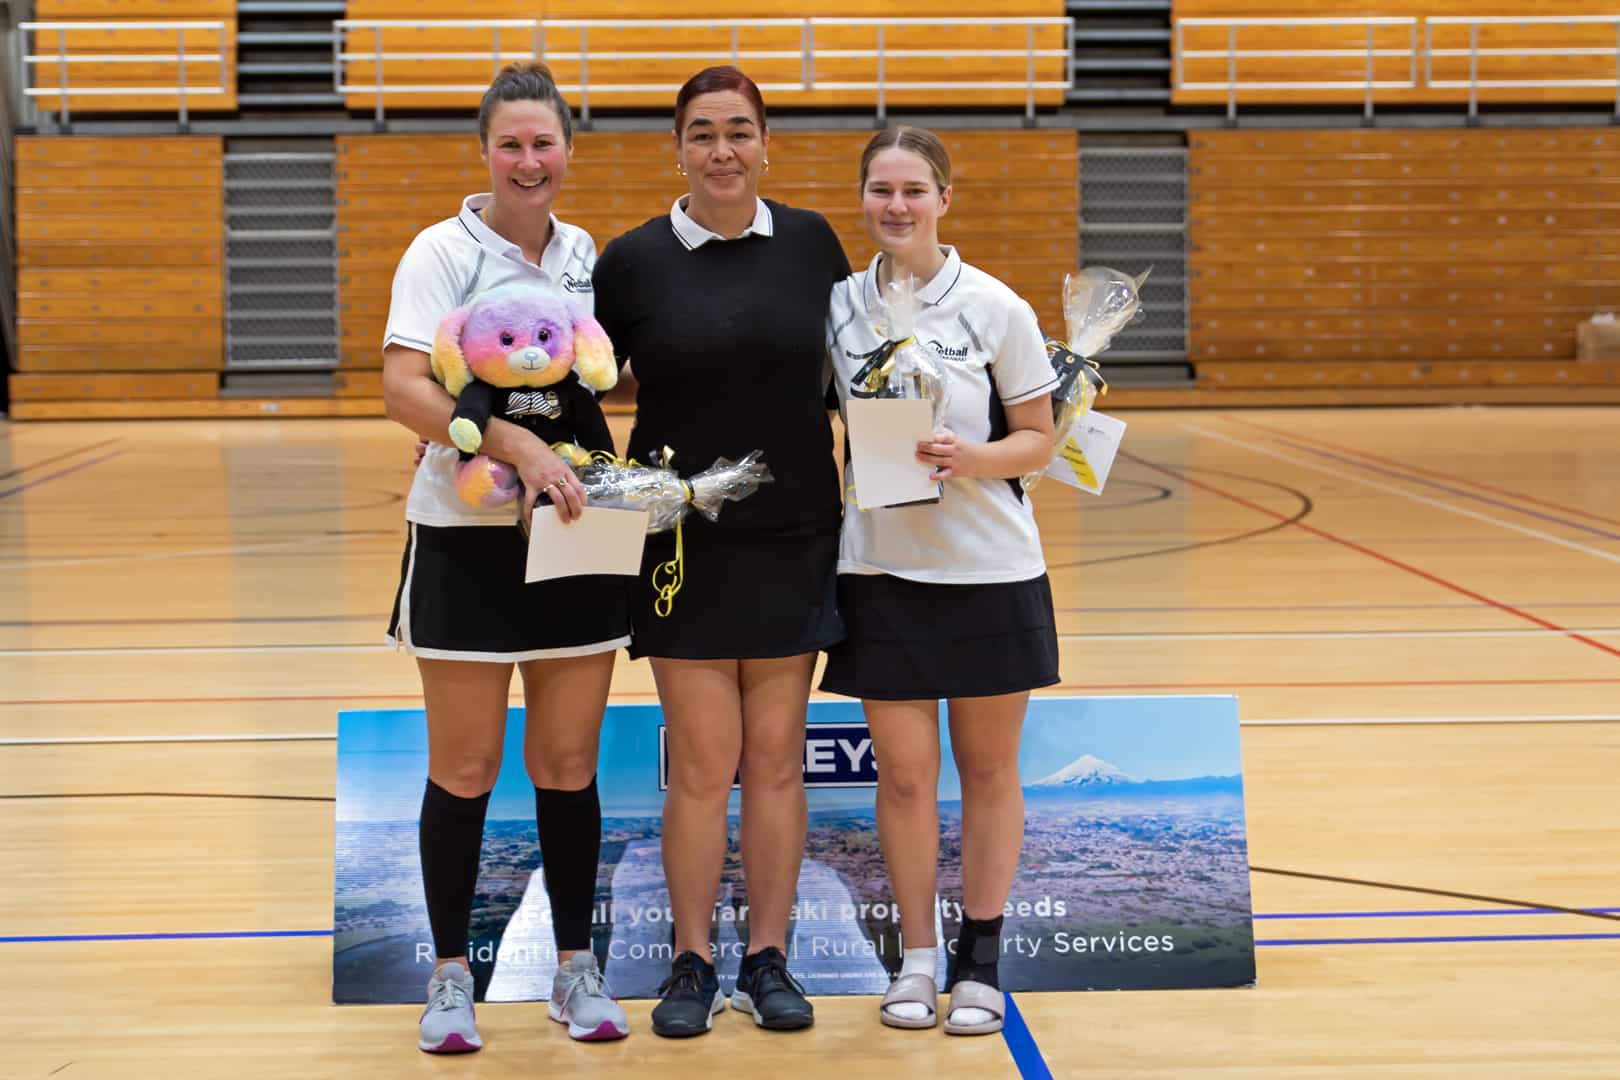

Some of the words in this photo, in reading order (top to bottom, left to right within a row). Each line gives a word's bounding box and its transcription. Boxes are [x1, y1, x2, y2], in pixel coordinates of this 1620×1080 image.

[1002, 896, 1067, 917] eeds
[812, 934, 885, 957] Rural
[1053, 930, 1174, 953] Services
